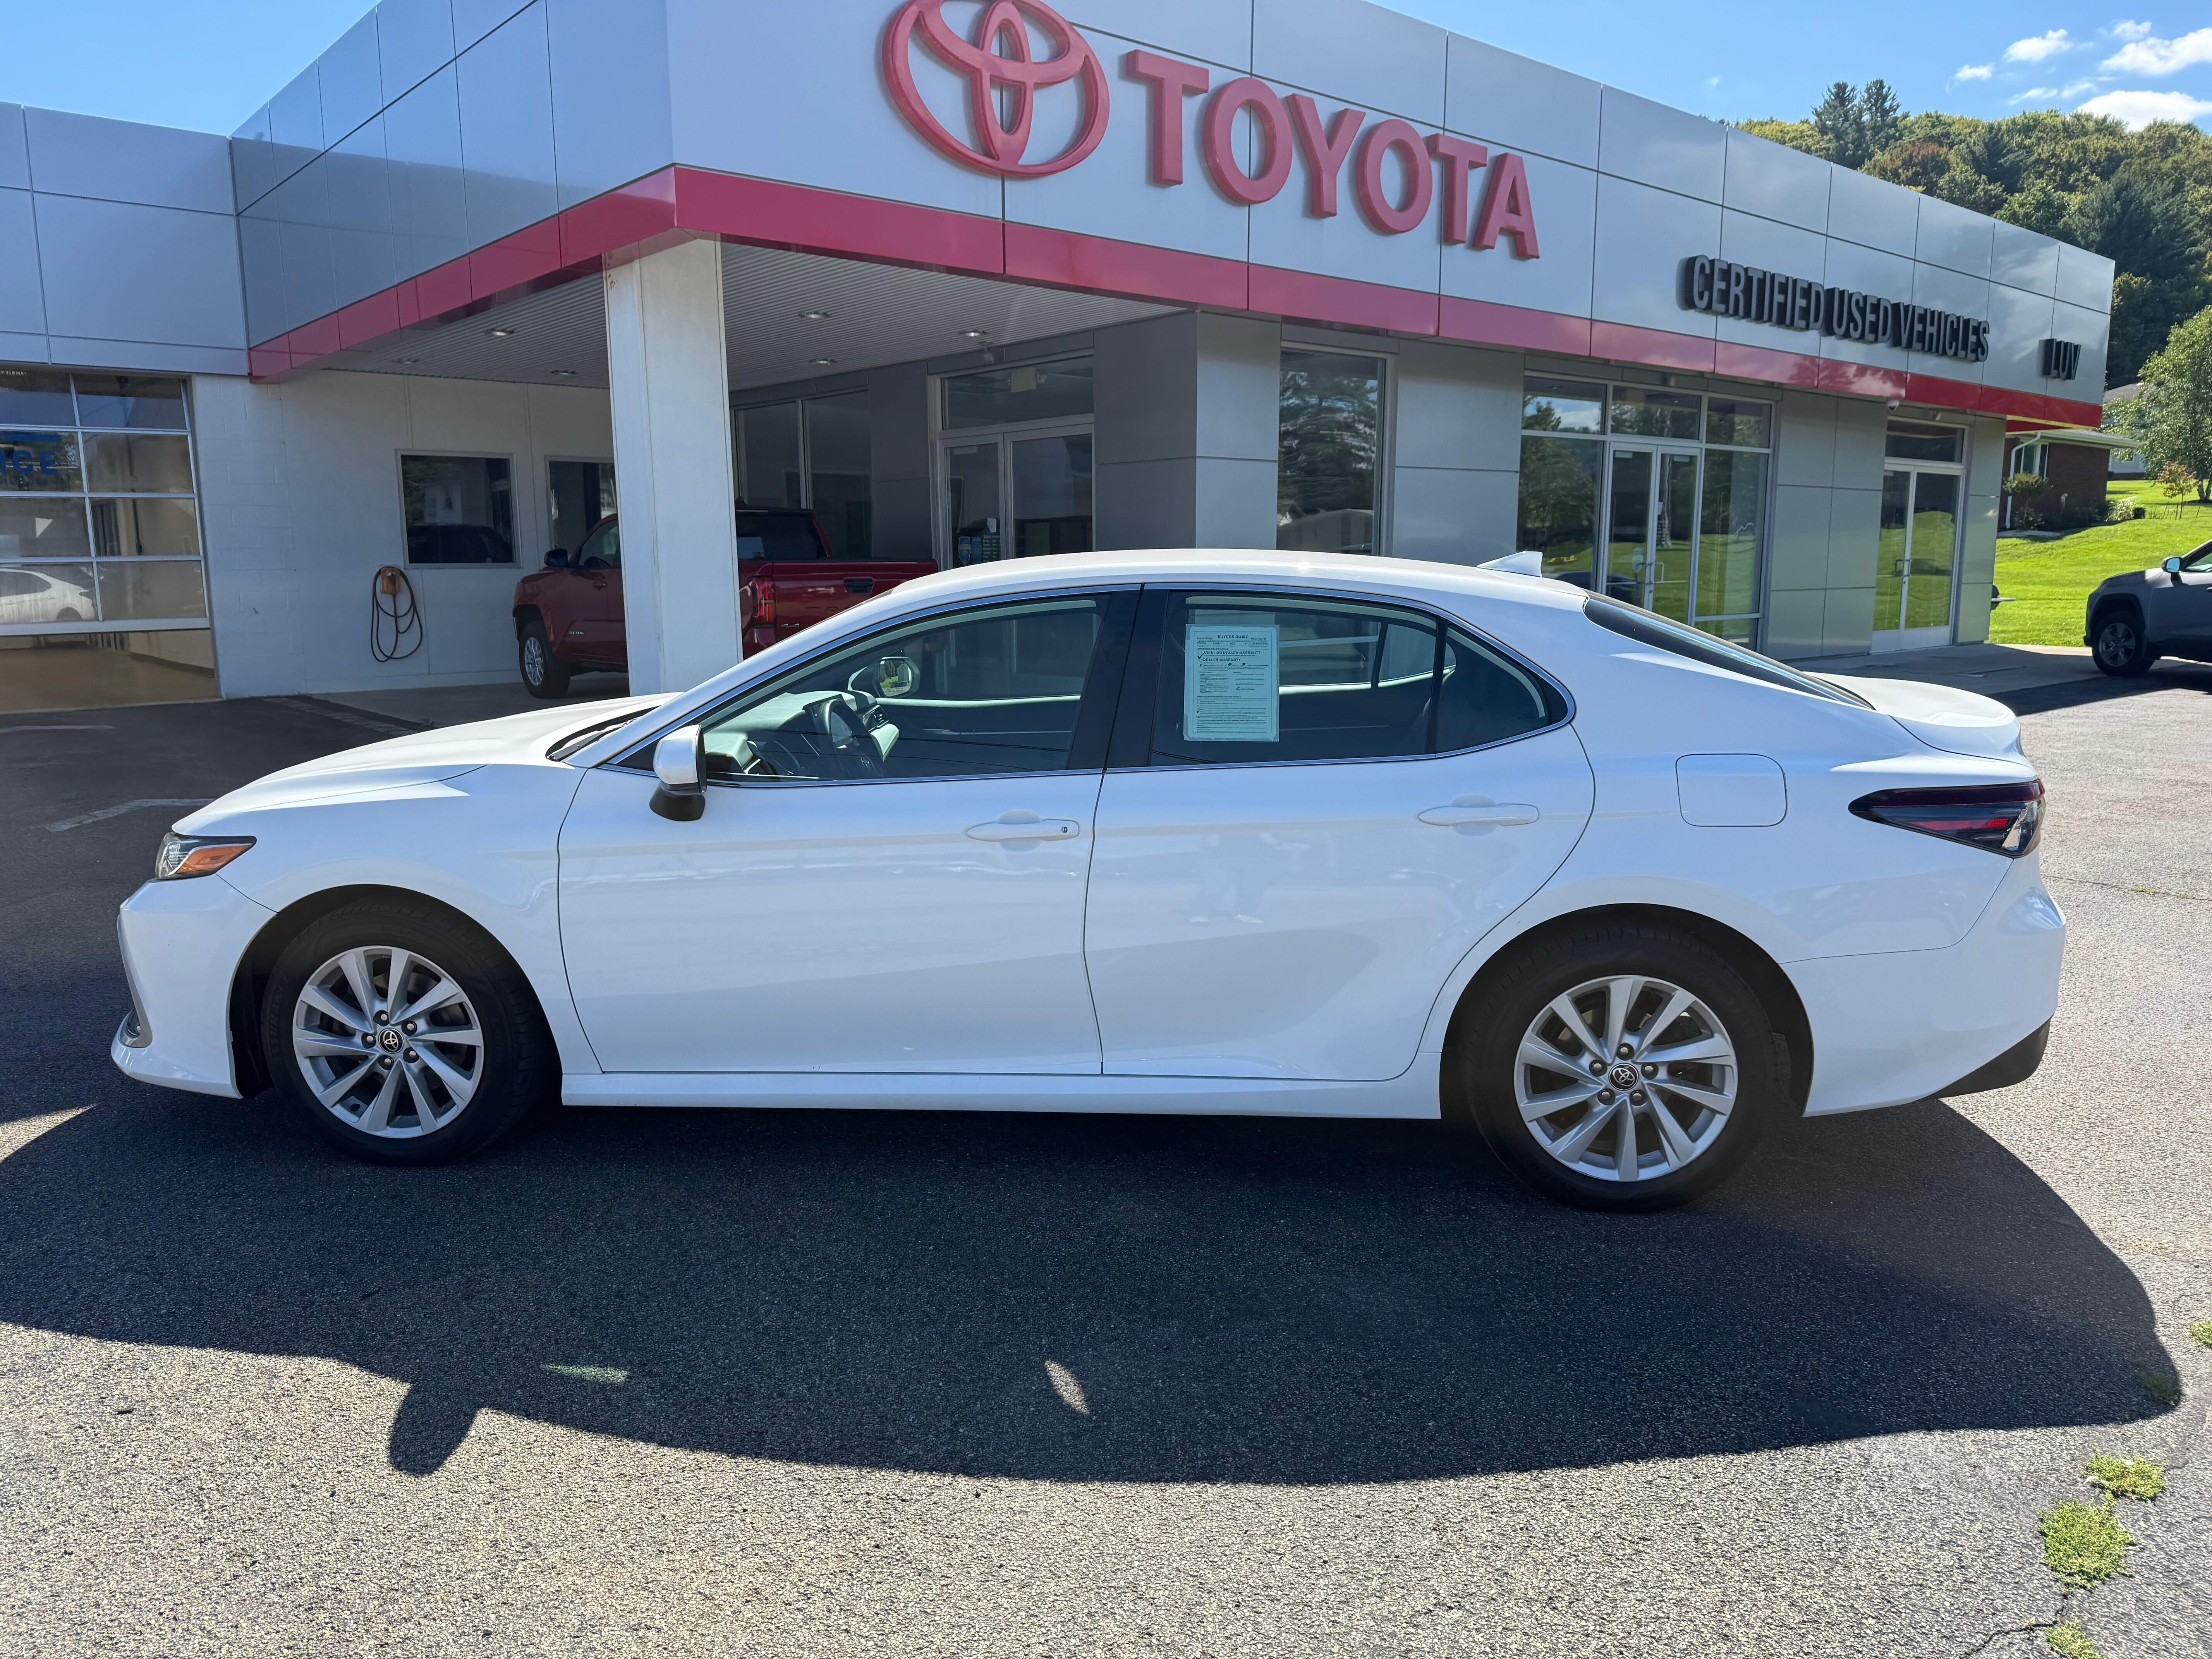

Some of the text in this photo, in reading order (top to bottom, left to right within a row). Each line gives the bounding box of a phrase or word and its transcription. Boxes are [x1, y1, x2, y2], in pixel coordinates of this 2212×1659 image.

[1126, 49, 1540, 259] TOYOTA
[1688, 254, 1990, 362] CERTIFIED USED VEHICLES
[2046, 338, 2081, 380] LUV
